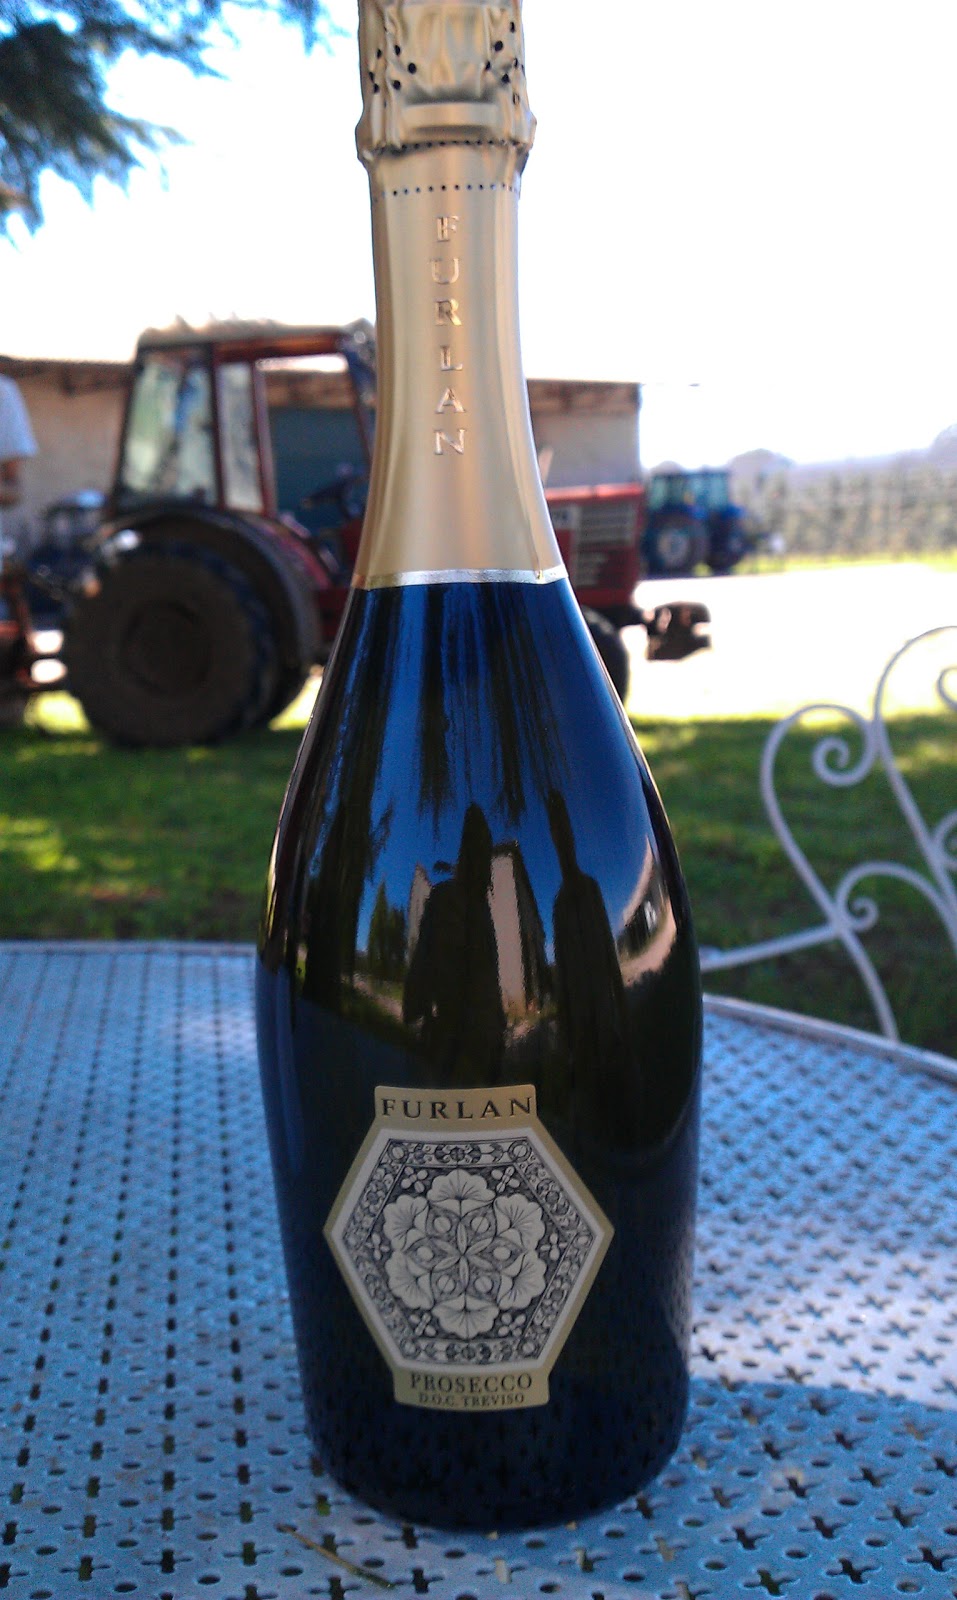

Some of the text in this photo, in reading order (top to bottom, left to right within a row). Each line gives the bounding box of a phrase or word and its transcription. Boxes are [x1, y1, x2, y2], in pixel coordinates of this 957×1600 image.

[428, 215, 467, 455] FURLAN
[381, 1097, 532, 1119] FURLAN
[410, 1372, 532, 1393] PROSECCO
[462, 1393, 525, 1407] TREVISO
